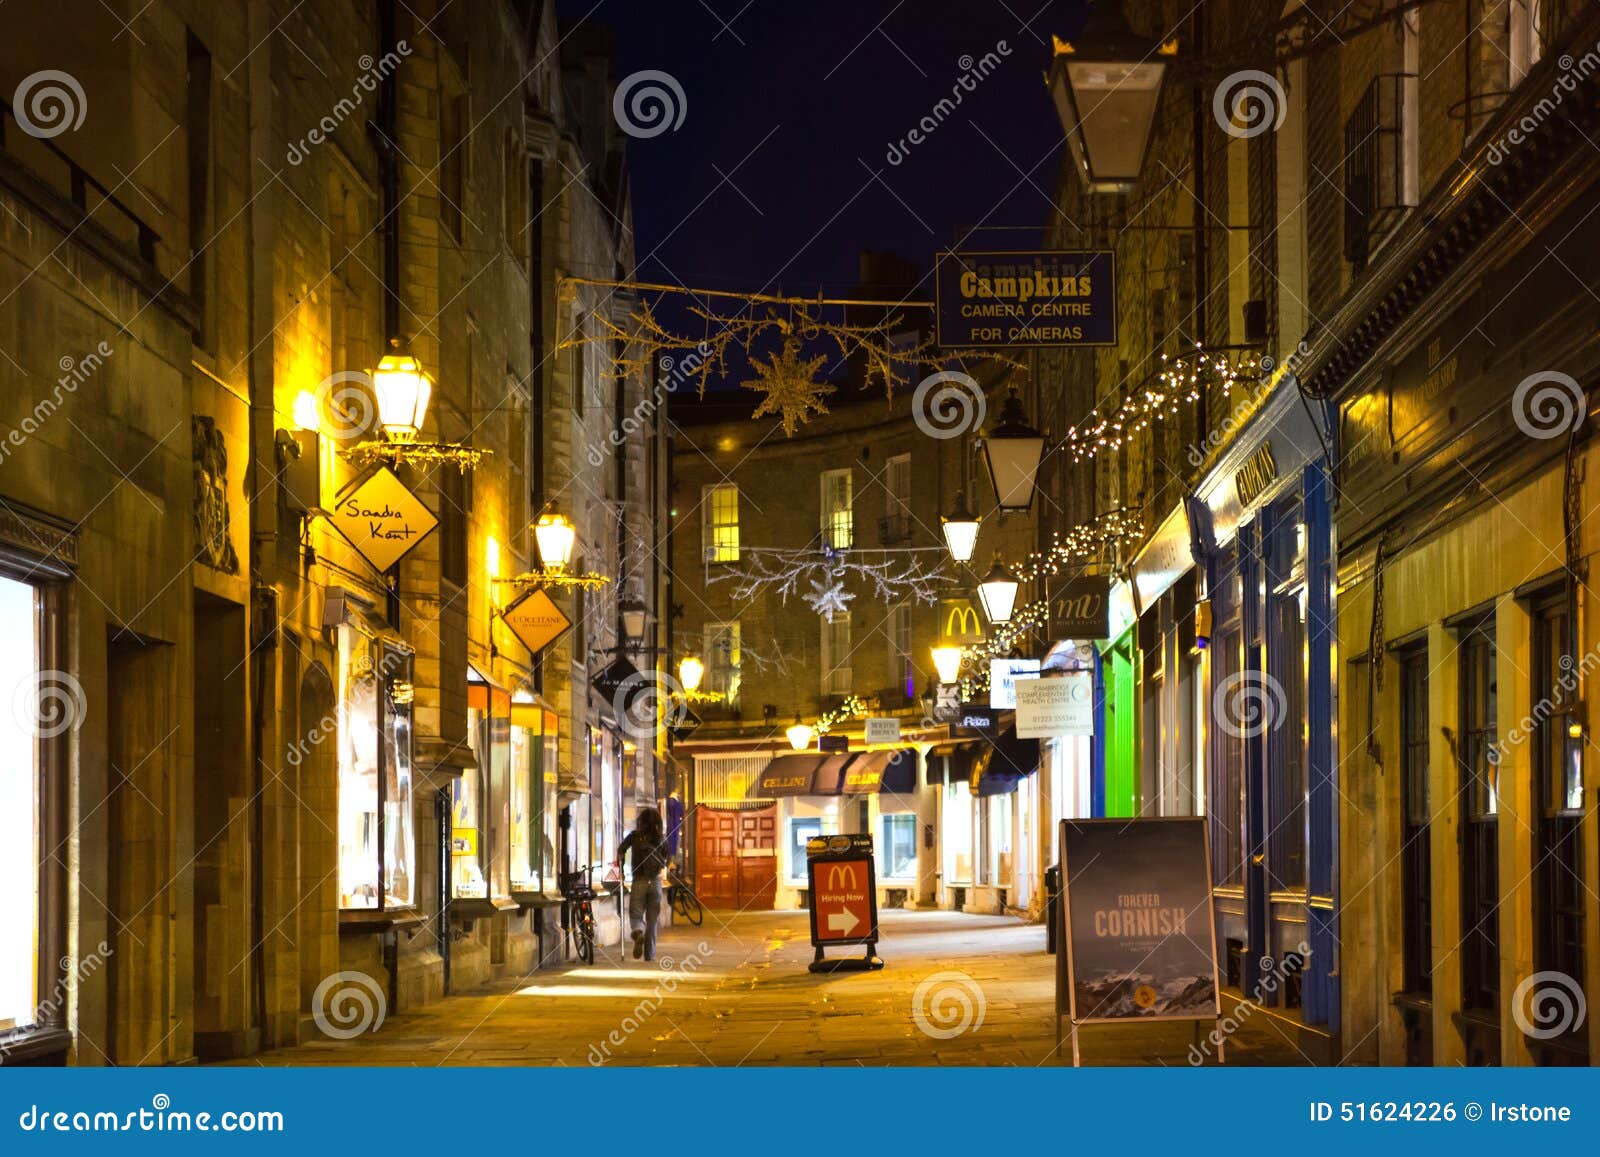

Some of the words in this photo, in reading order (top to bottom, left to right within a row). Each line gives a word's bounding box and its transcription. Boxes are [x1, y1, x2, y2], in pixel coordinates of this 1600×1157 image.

[960, 270, 1092, 302] Campkins
[961, 304, 1025, 317] CAMERA
[1031, 303, 1091, 316] CENTRE
[971, 328, 1002, 340] FOR
[1008, 327, 1083, 340] CAMERAS
[346, 499, 402, 519] Sandra
[370, 521, 417, 540] Kant
[821, 894, 846, 904] Hiring
[846, 893, 865, 902] Now
[1118, 894, 1160, 908] FOREVER
[1095, 908, 1187, 937] CORNISH
